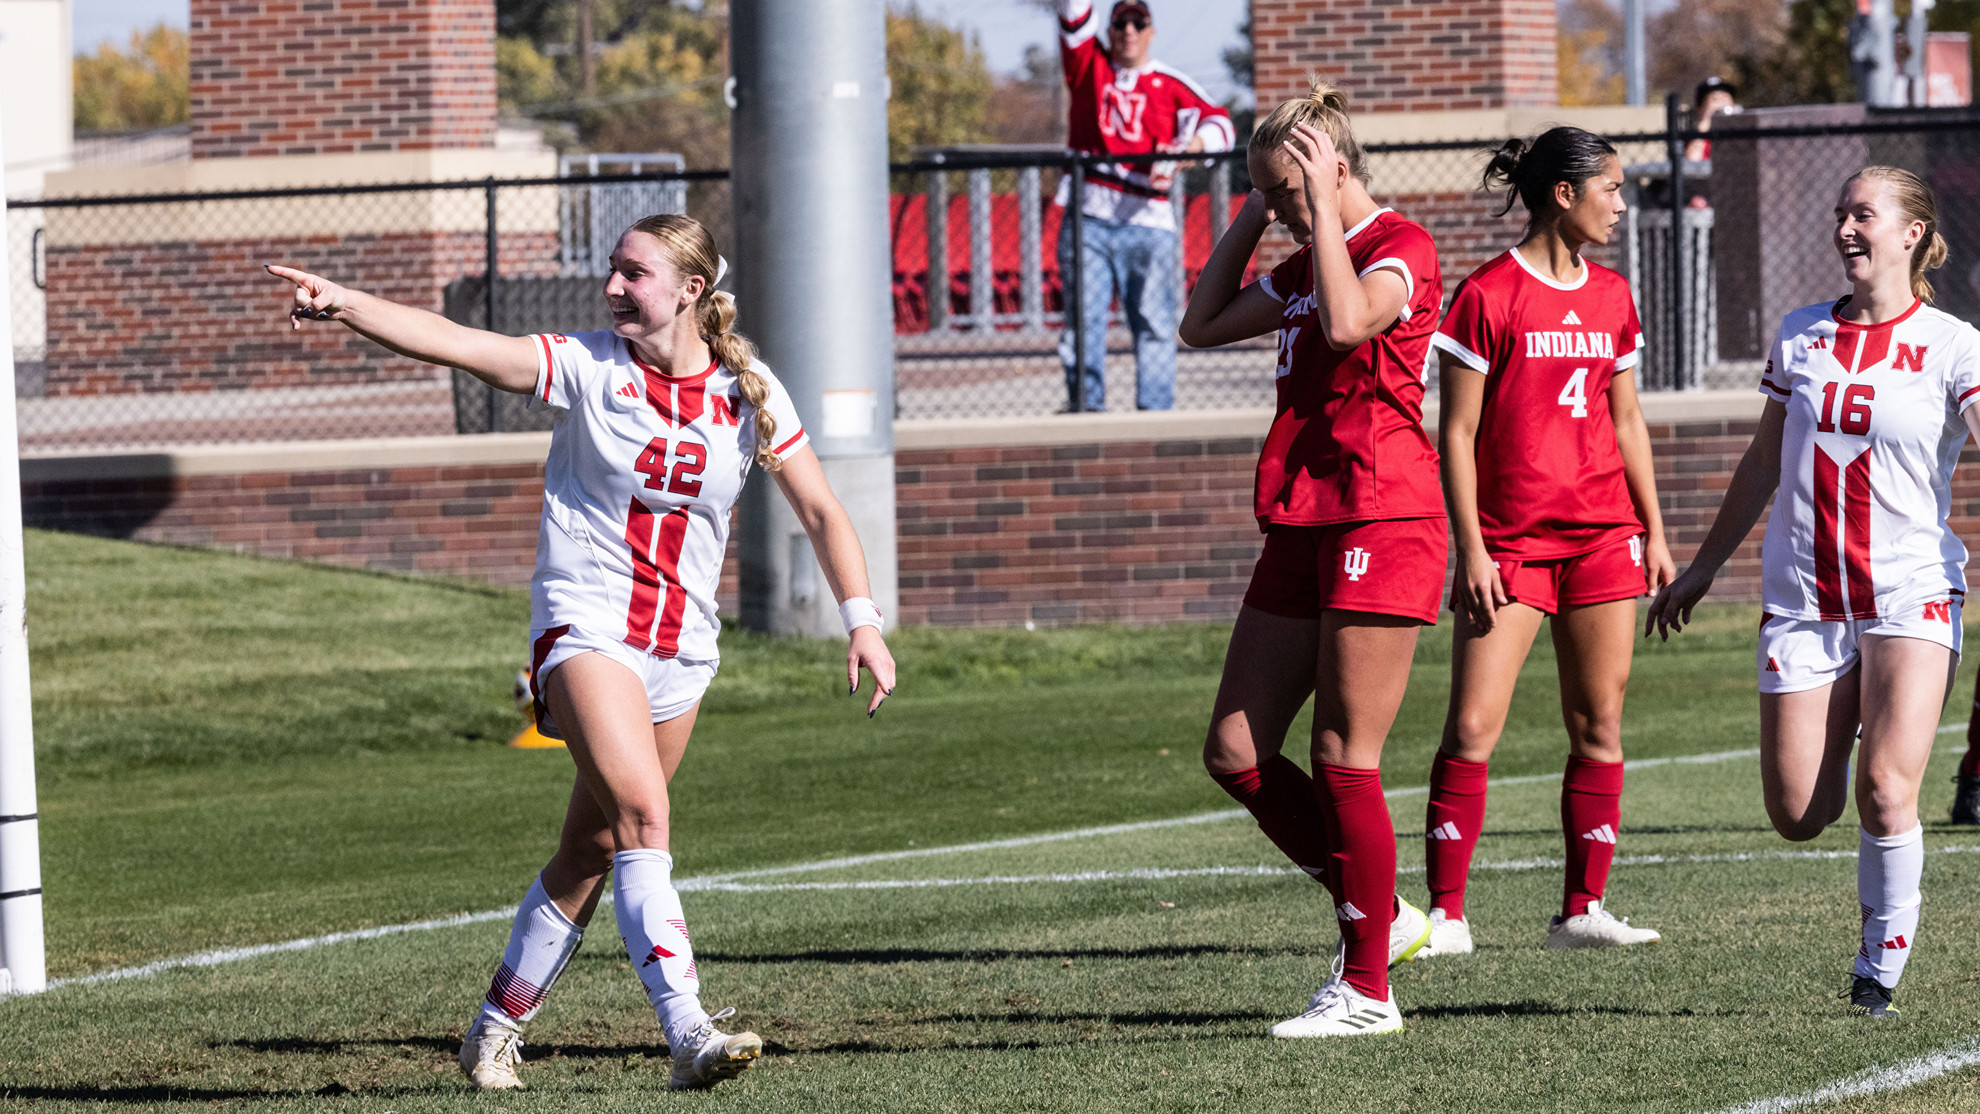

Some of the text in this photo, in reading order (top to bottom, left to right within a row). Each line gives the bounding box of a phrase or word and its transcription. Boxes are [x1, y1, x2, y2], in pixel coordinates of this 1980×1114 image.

[1098, 83, 1147, 142] N
[1525, 331, 1614, 359] INDIANA
[1890, 340, 1929, 373] N
[709, 393, 742, 428] N
[1558, 367, 1589, 418] 4
[1817, 381, 1875, 436] 16
[634, 436, 707, 498] 42
[1922, 598, 1955, 625] N
